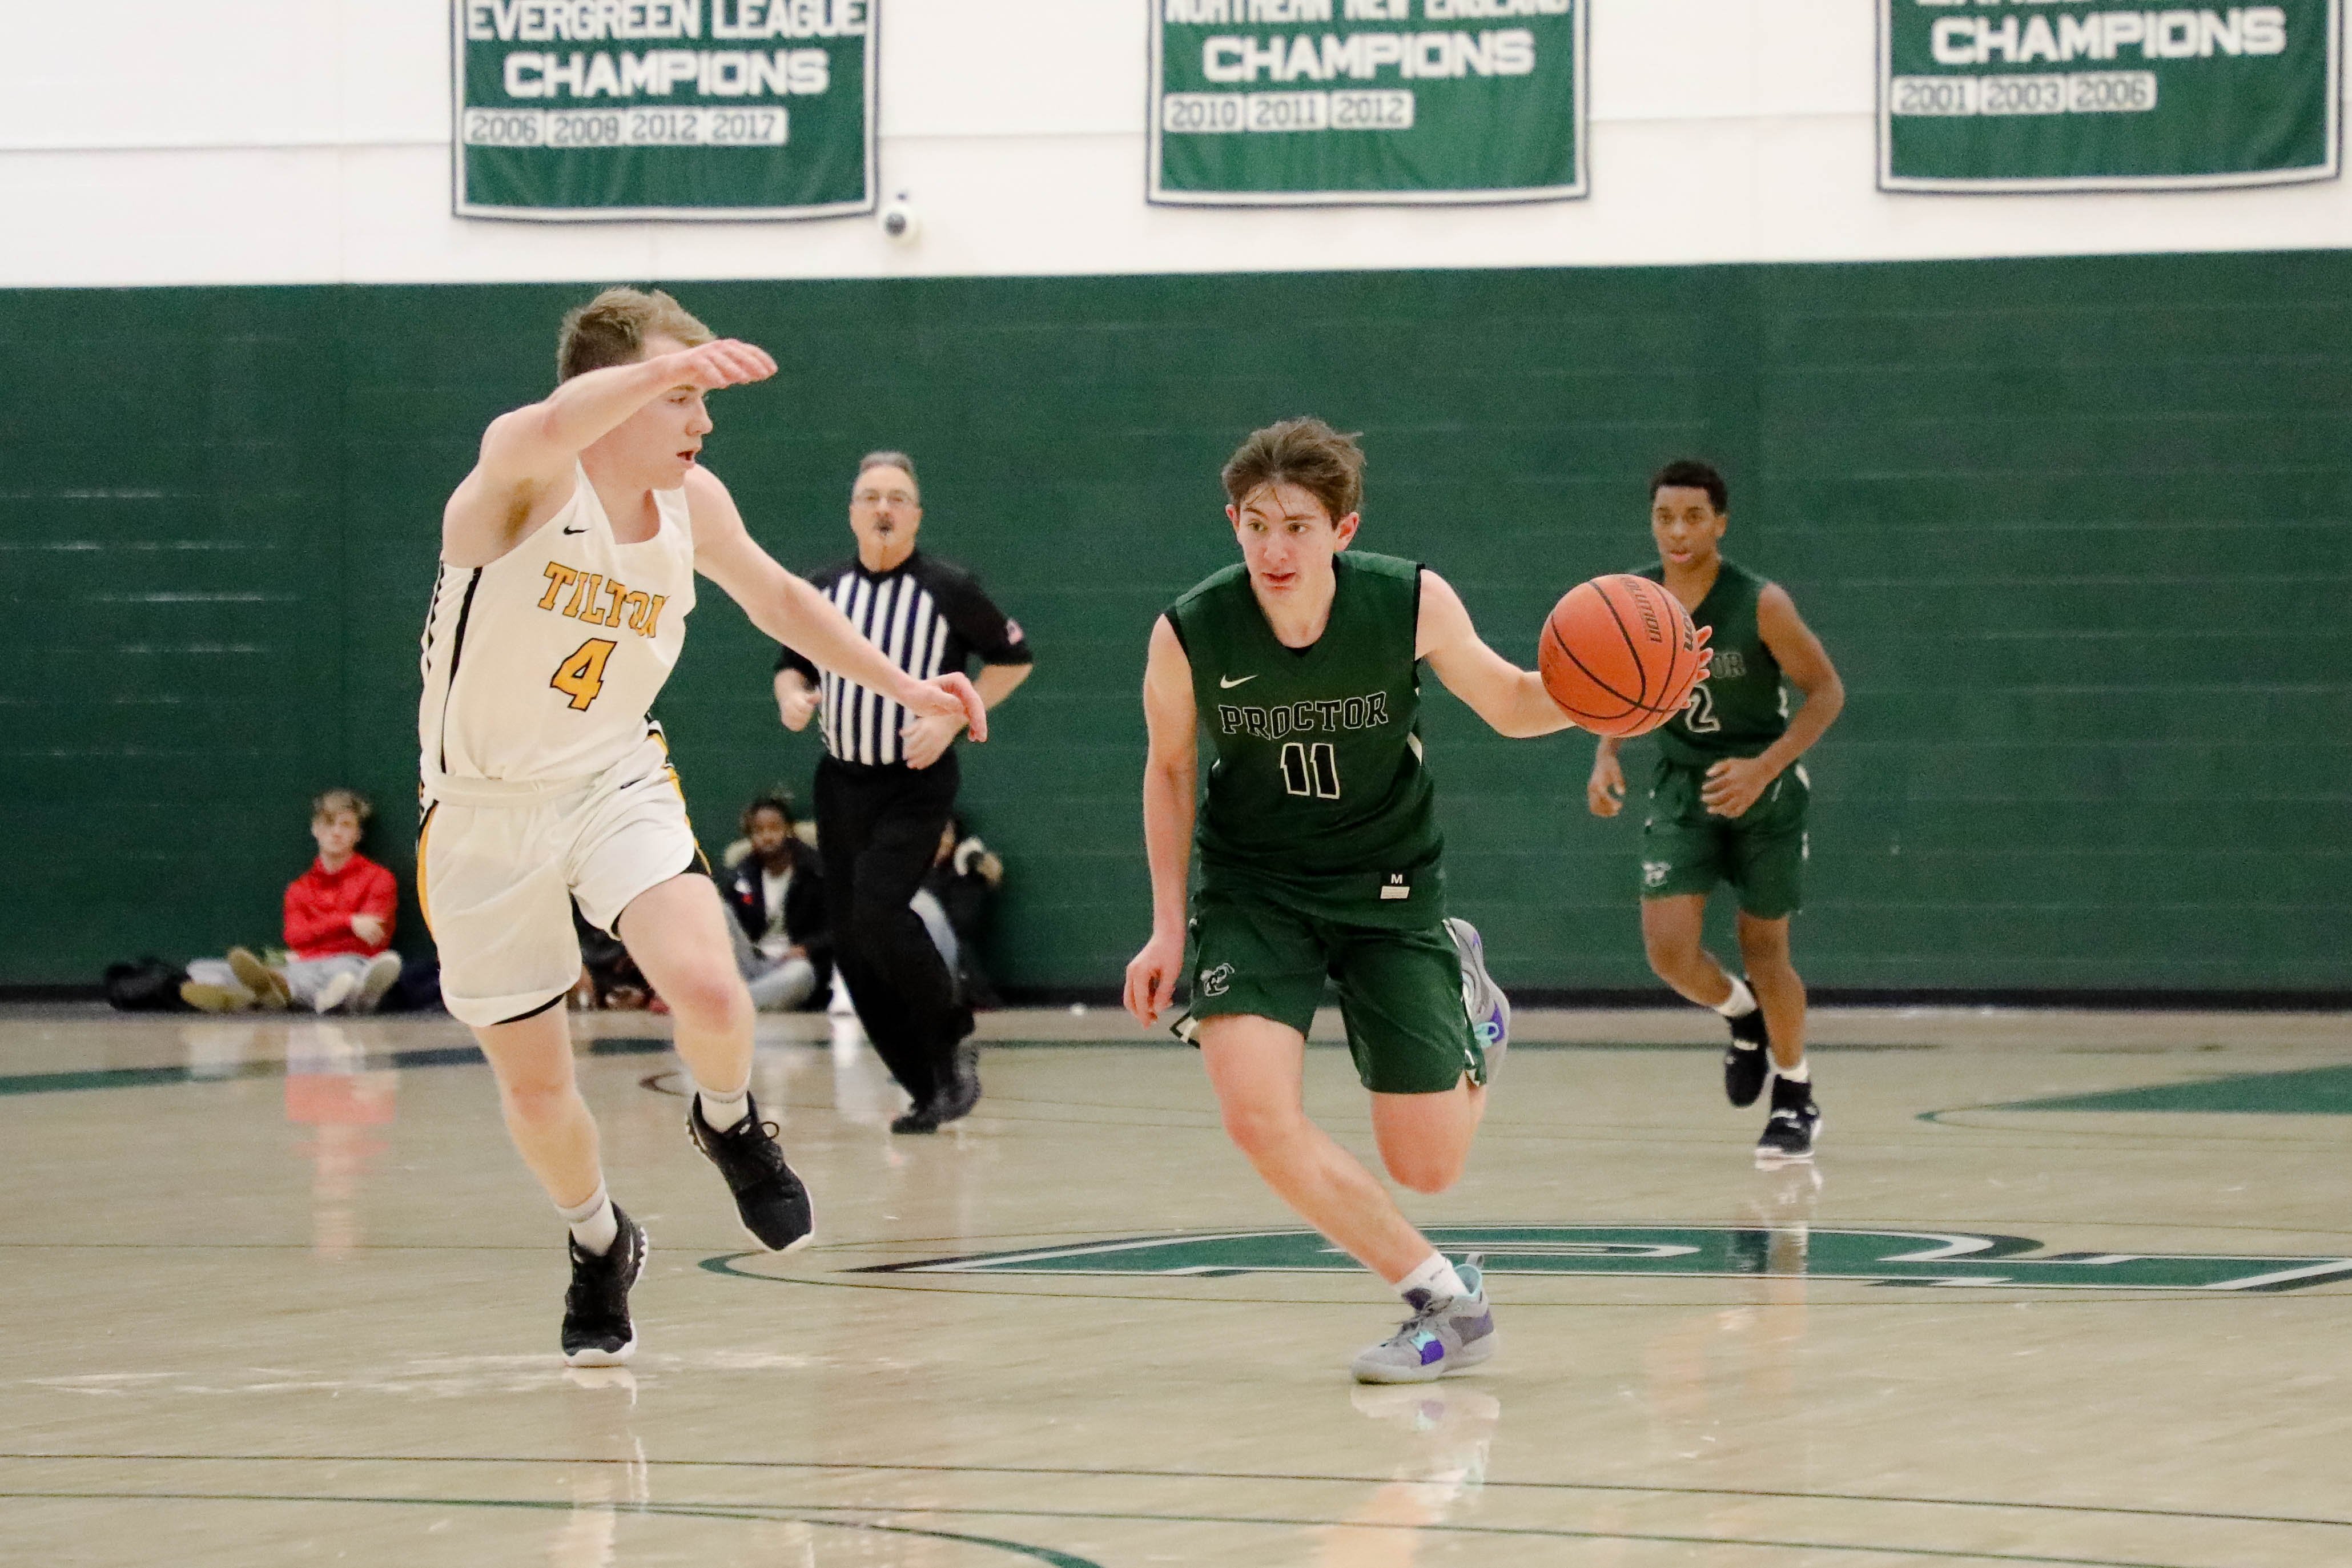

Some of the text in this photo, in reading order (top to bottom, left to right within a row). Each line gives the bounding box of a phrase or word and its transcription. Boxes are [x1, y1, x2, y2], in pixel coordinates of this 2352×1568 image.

[467, 0, 868, 40] EVERGREEN LEAGUE
[1931, 7, 2287, 64] CHAMPIONS
[504, 49, 830, 97] CHAMPIONS
[1203, 29, 1535, 82] CHAMPIONS
[1171, 96, 1404, 127] 2010 2011 2012
[1900, 83, 1965, 111] 2001
[470, 116, 537, 142] 2006
[630, 114, 697, 142] 2012
[711, 114, 776, 141] 2017
[537, 561, 670, 638] TILTON
[549, 637, 617, 712] 4
[1218, 690, 1389, 741] PROCTOR
[1684, 684, 1721, 733] 2
[1280, 742, 1340, 799] 11
[1391, 873, 1403, 884] M
